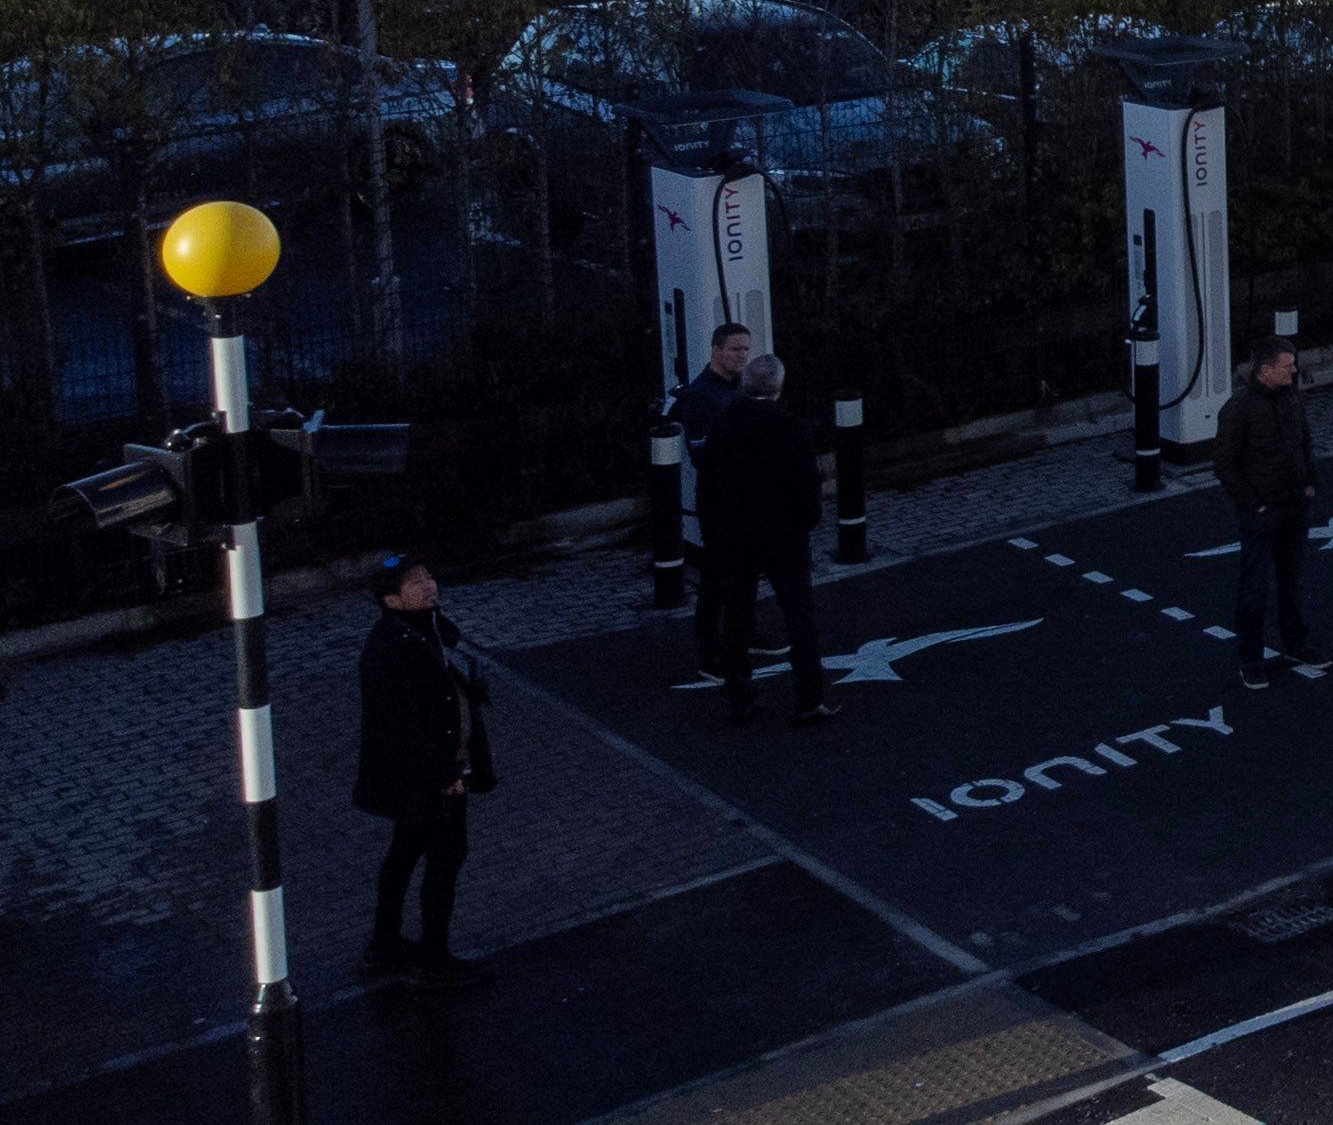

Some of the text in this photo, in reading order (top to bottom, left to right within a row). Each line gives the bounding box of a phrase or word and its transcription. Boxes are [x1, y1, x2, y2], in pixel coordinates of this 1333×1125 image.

[1193, 121, 1208, 187] IONITY
[724, 186, 744, 262] IONITY
[910, 704, 1235, 822] IONITY
